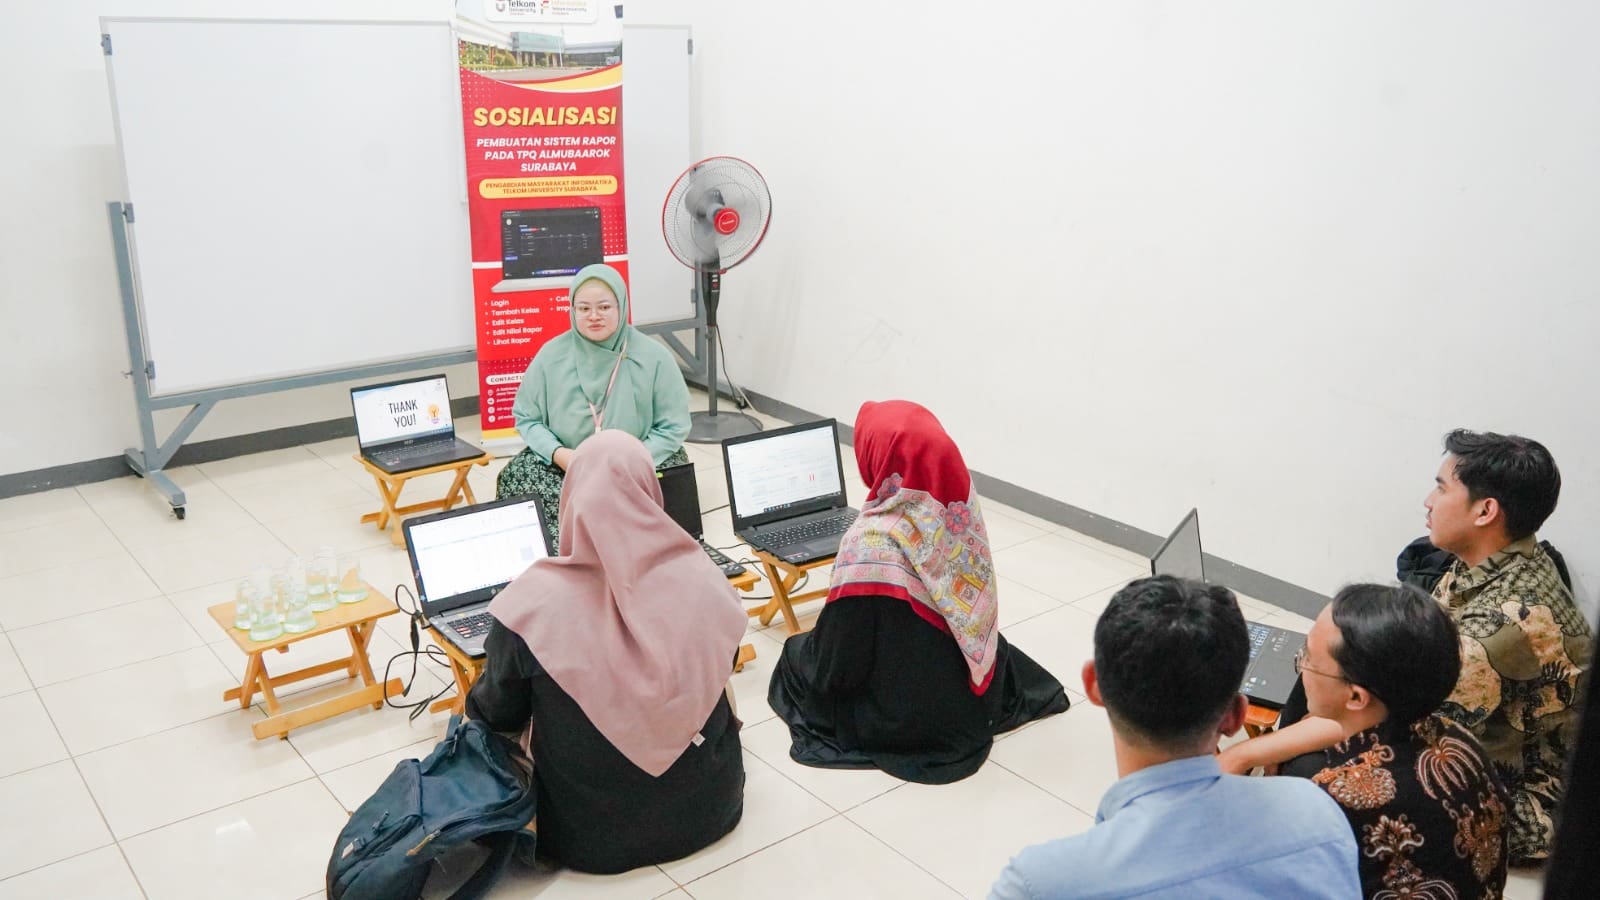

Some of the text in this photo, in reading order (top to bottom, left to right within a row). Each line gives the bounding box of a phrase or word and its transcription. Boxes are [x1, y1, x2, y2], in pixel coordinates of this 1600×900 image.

[508, 0, 536, 8] Telkom
[473, 106, 617, 127] SOSIALISASI
[476, 136, 616, 148] PEMBUATAN SISTEM RAPOR
[484, 148, 611, 160] PADA TPQ ALMUBAAROK
[520, 162, 577, 172] SURABAYA
[491, 300, 509, 308] Login
[491, 308, 520, 316] Tambah
[522, 327, 543, 335] Rapor
[511, 337, 531, 345] Rapor
[388, 399, 418, 414] THANK
[394, 413, 417, 428] YOU!
